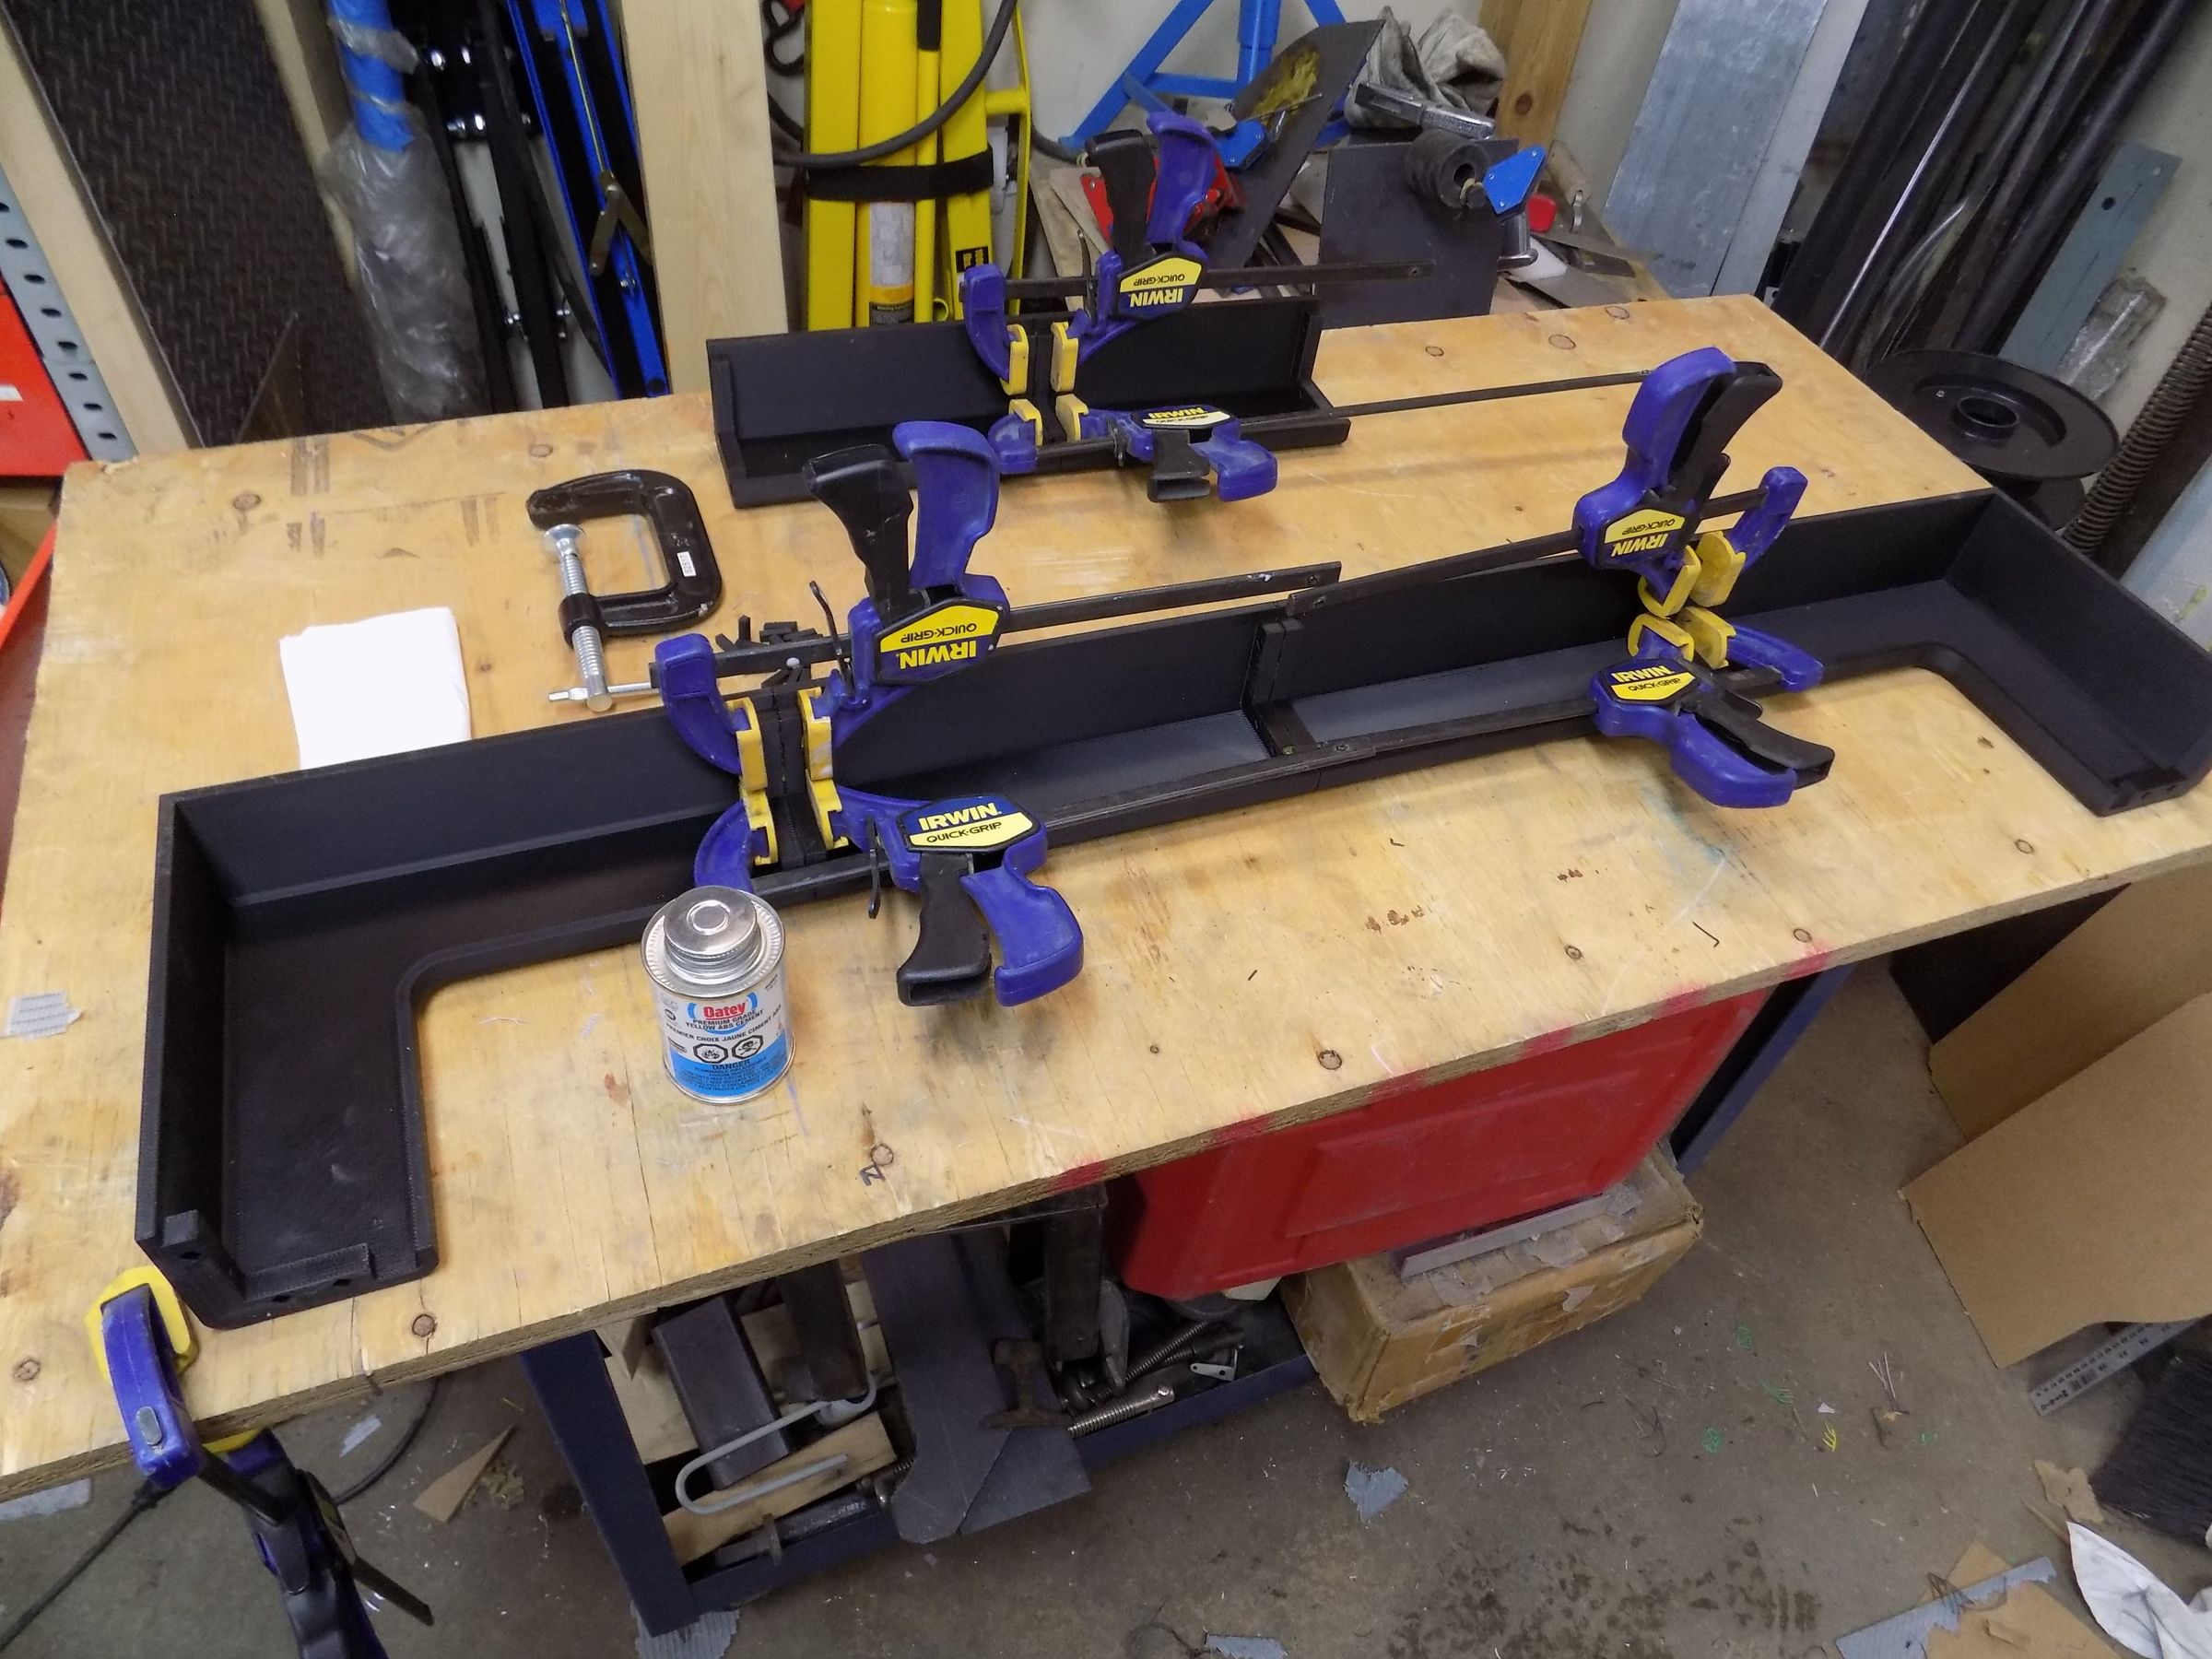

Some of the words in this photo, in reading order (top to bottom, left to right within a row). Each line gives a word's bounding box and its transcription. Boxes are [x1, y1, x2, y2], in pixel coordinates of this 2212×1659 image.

[1130, 288, 1183, 308] IRWIN
[1147, 407, 1206, 418] IRWIN
[1610, 533, 1669, 558] IRWIN
[899, 640, 977, 670] IRWIN
[1610, 665, 1673, 683] IRWIN
[918, 802, 999, 831] IRWIN
[686, 1021, 715, 1030] YELLOW
[718, 1022, 734, 1030] ABS
[735, 1008, 764, 1027] CEMENT
[693, 1018, 730, 1026] PREMIUM
[733, 1009, 756, 1023] GRADE
[703, 1001, 746, 1018] Oatey
[666, 1022, 695, 1040] PREMIER
[722, 1030, 747, 1042] JAUNE
[747, 1015, 771, 1035] CIMENT
[712, 1058, 751, 1070] DANGER
